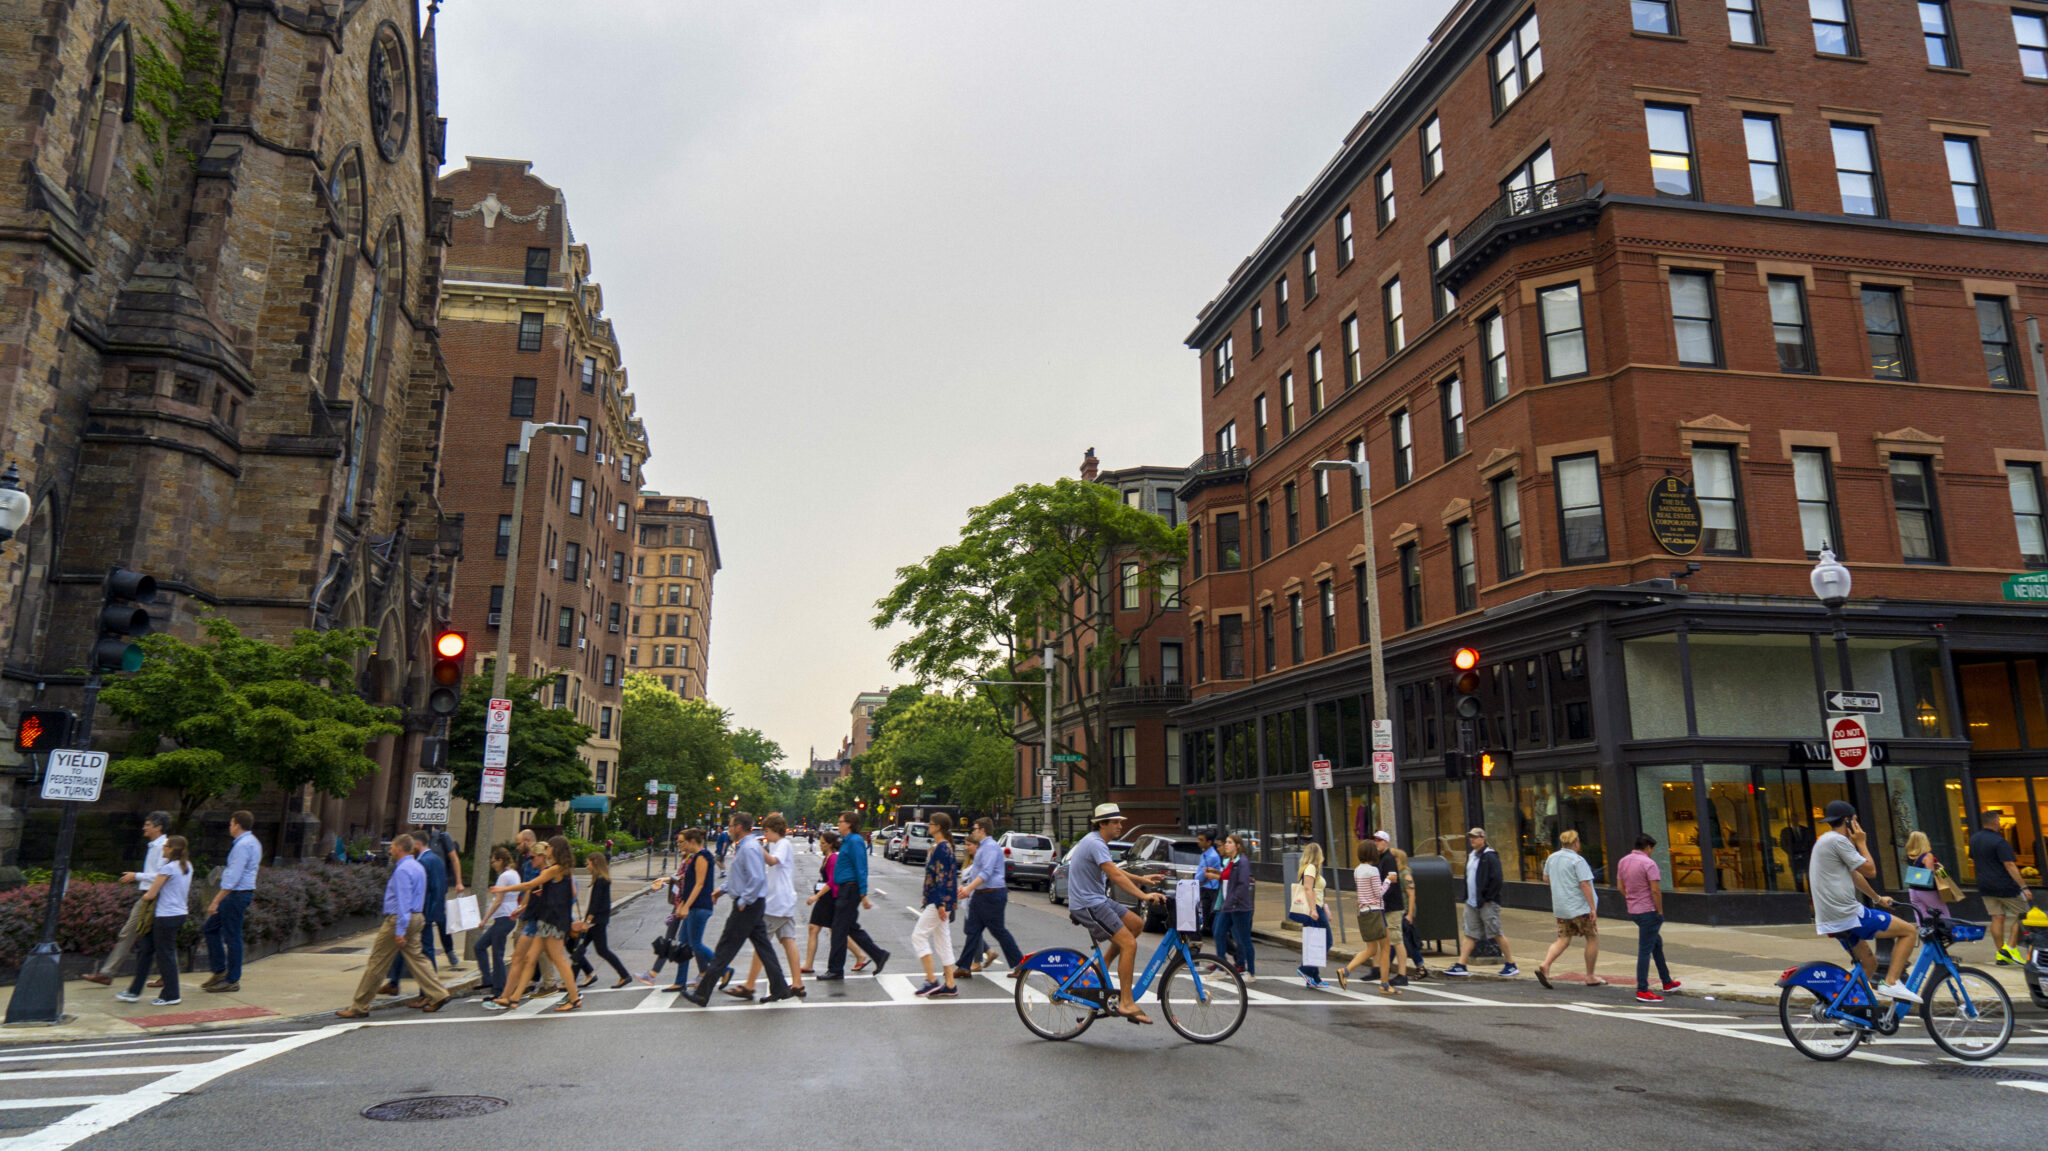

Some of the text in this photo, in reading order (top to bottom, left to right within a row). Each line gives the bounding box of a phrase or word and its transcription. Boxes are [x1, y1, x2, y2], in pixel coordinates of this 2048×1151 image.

[1842, 697, 1875, 707] ONE WAY
[1834, 728, 1861, 738] DO NOT
[1840, 748, 1862, 758] ENTER
[56, 753, 102, 768] YIELD
[50, 774, 98, 786] PEDESTRIANS
[416, 776, 449, 789] TRUCKS
[64, 785, 94, 797] TURNS
[414, 797, 446, 810] BUSES
[411, 812, 446, 821] EXCLUDED
